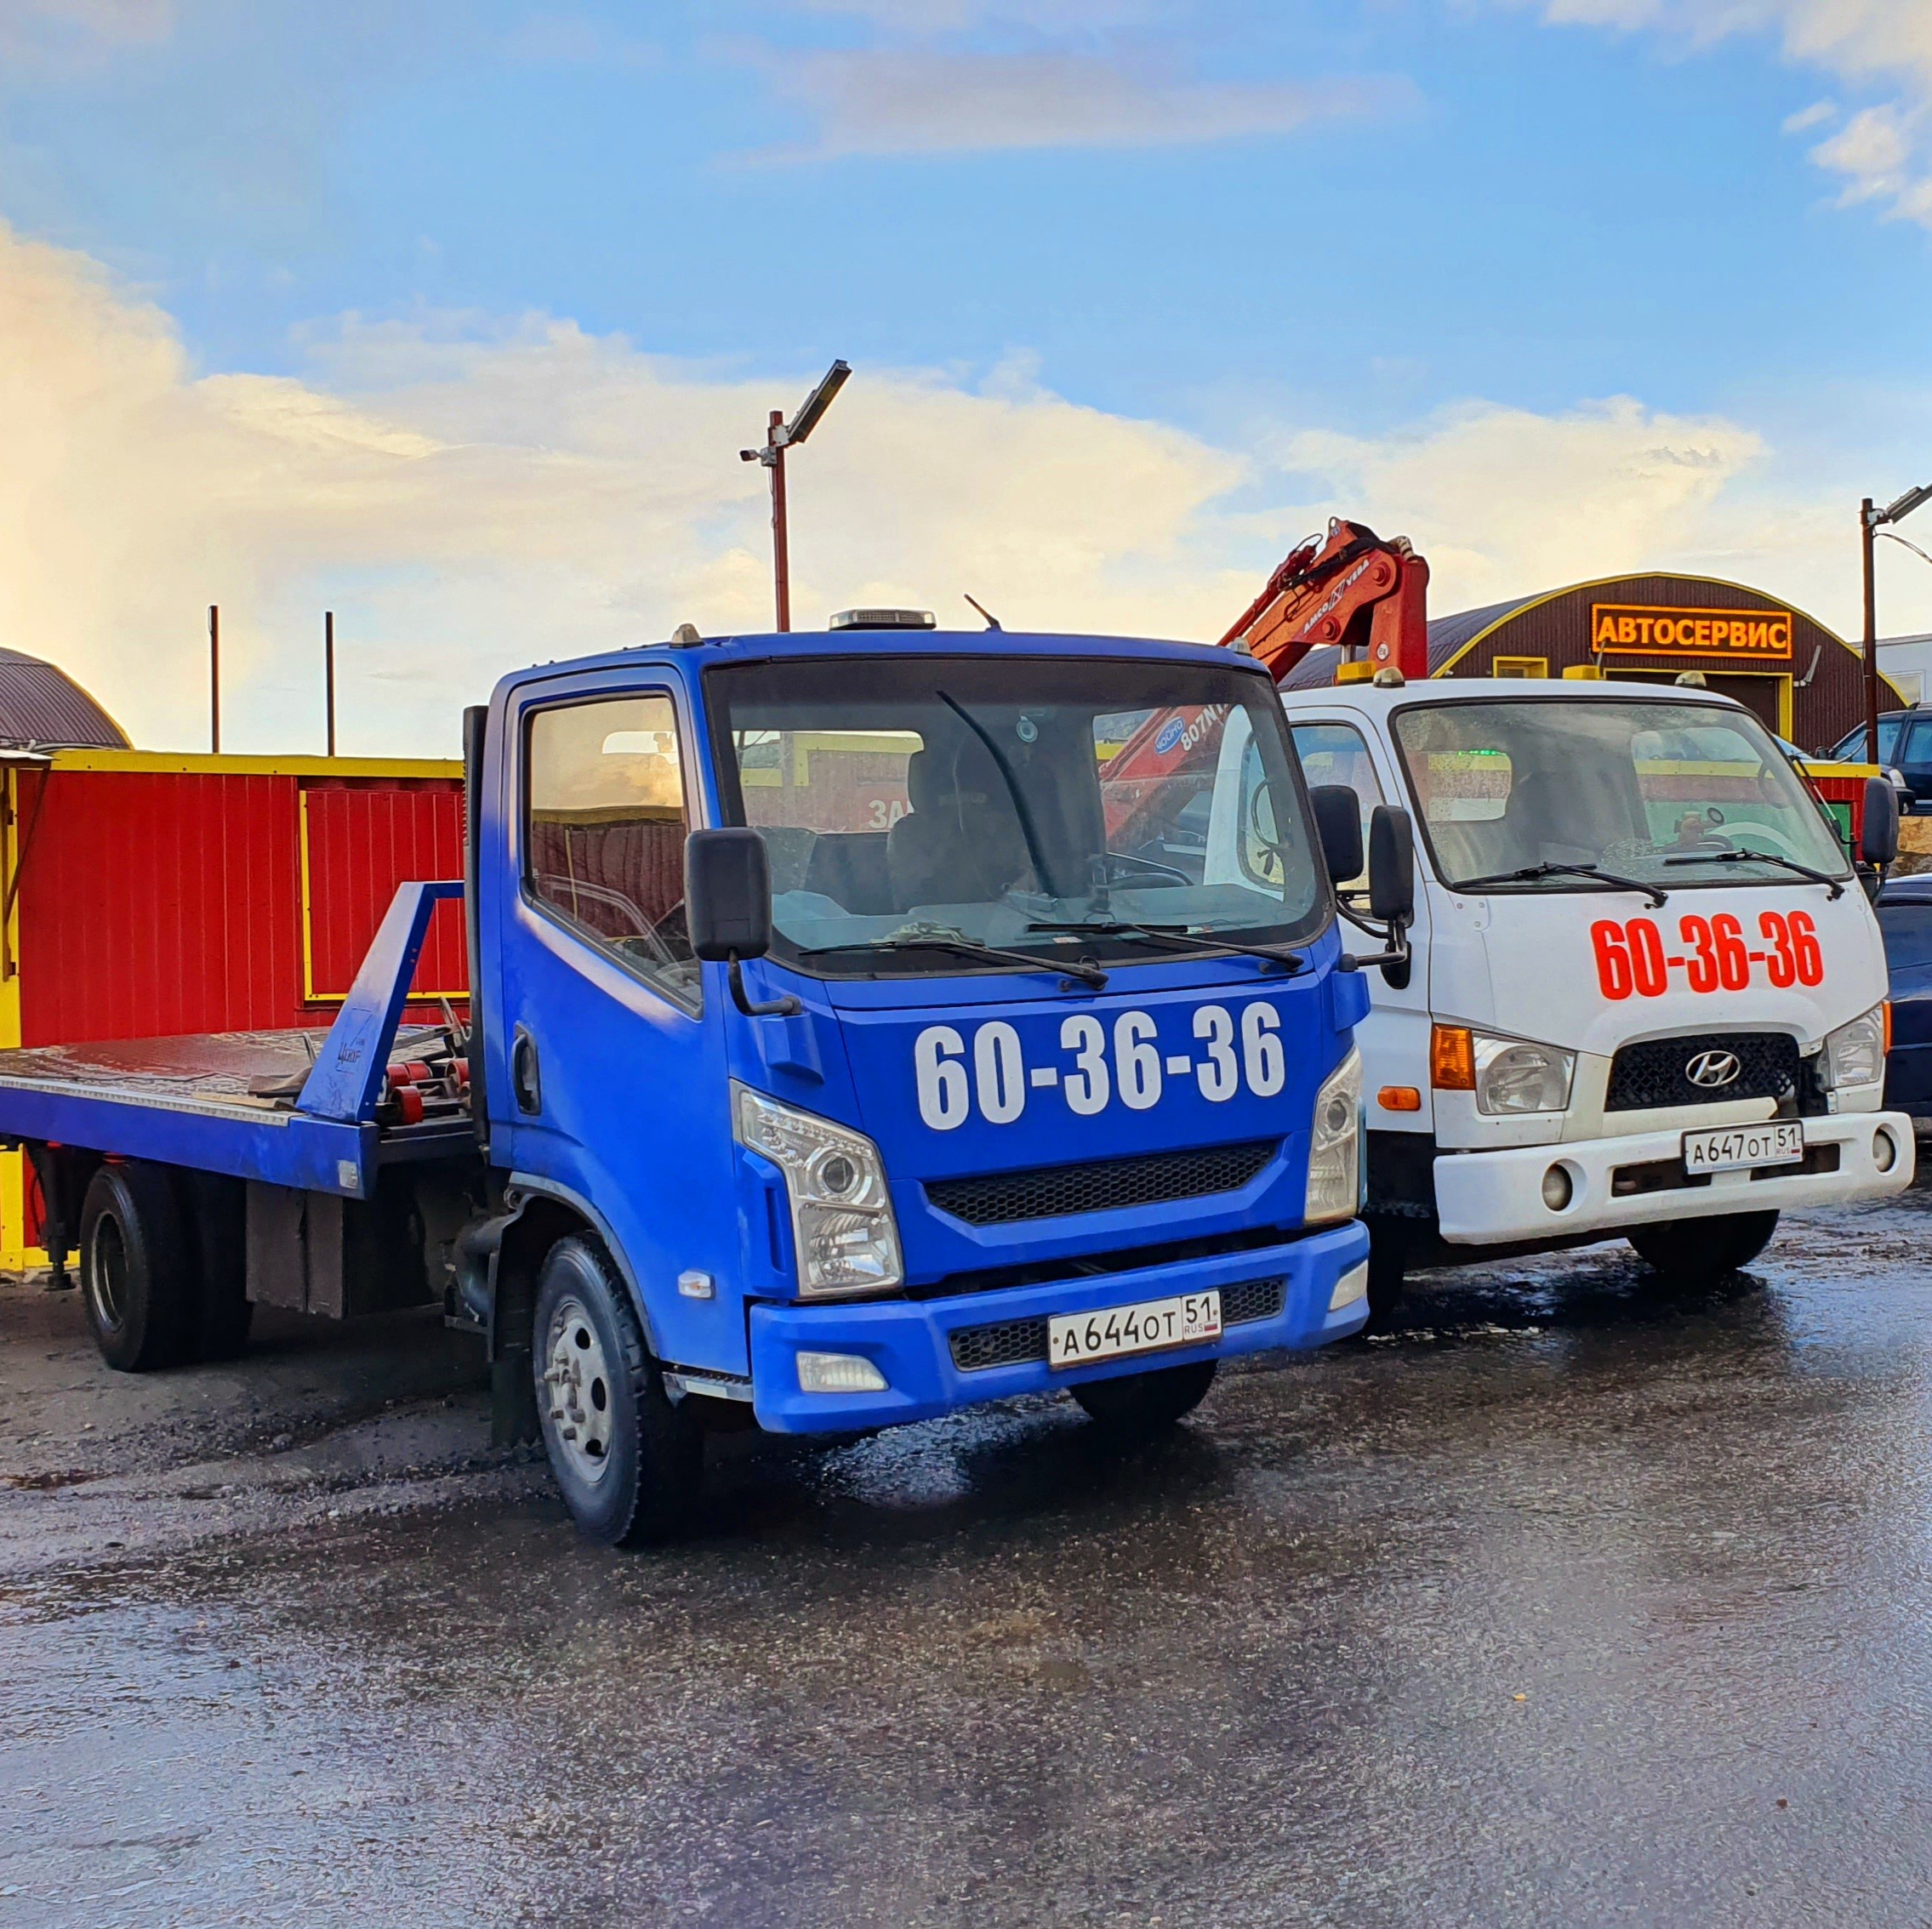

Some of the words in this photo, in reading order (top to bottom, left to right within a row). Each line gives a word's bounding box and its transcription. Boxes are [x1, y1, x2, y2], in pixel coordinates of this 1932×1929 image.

[1598, 616, 1787, 648] АВТОСЕРВИС
[868, 799, 915, 830] ЗА
[1591, 911, 1823, 999] 60-36-36
[914, 1001, 1285, 1130] 60-36-36
[1777, 1127, 1796, 1147] 51
[1186, 1296, 1211, 1323] 51
[1184, 1323, 1204, 1334] RUS
